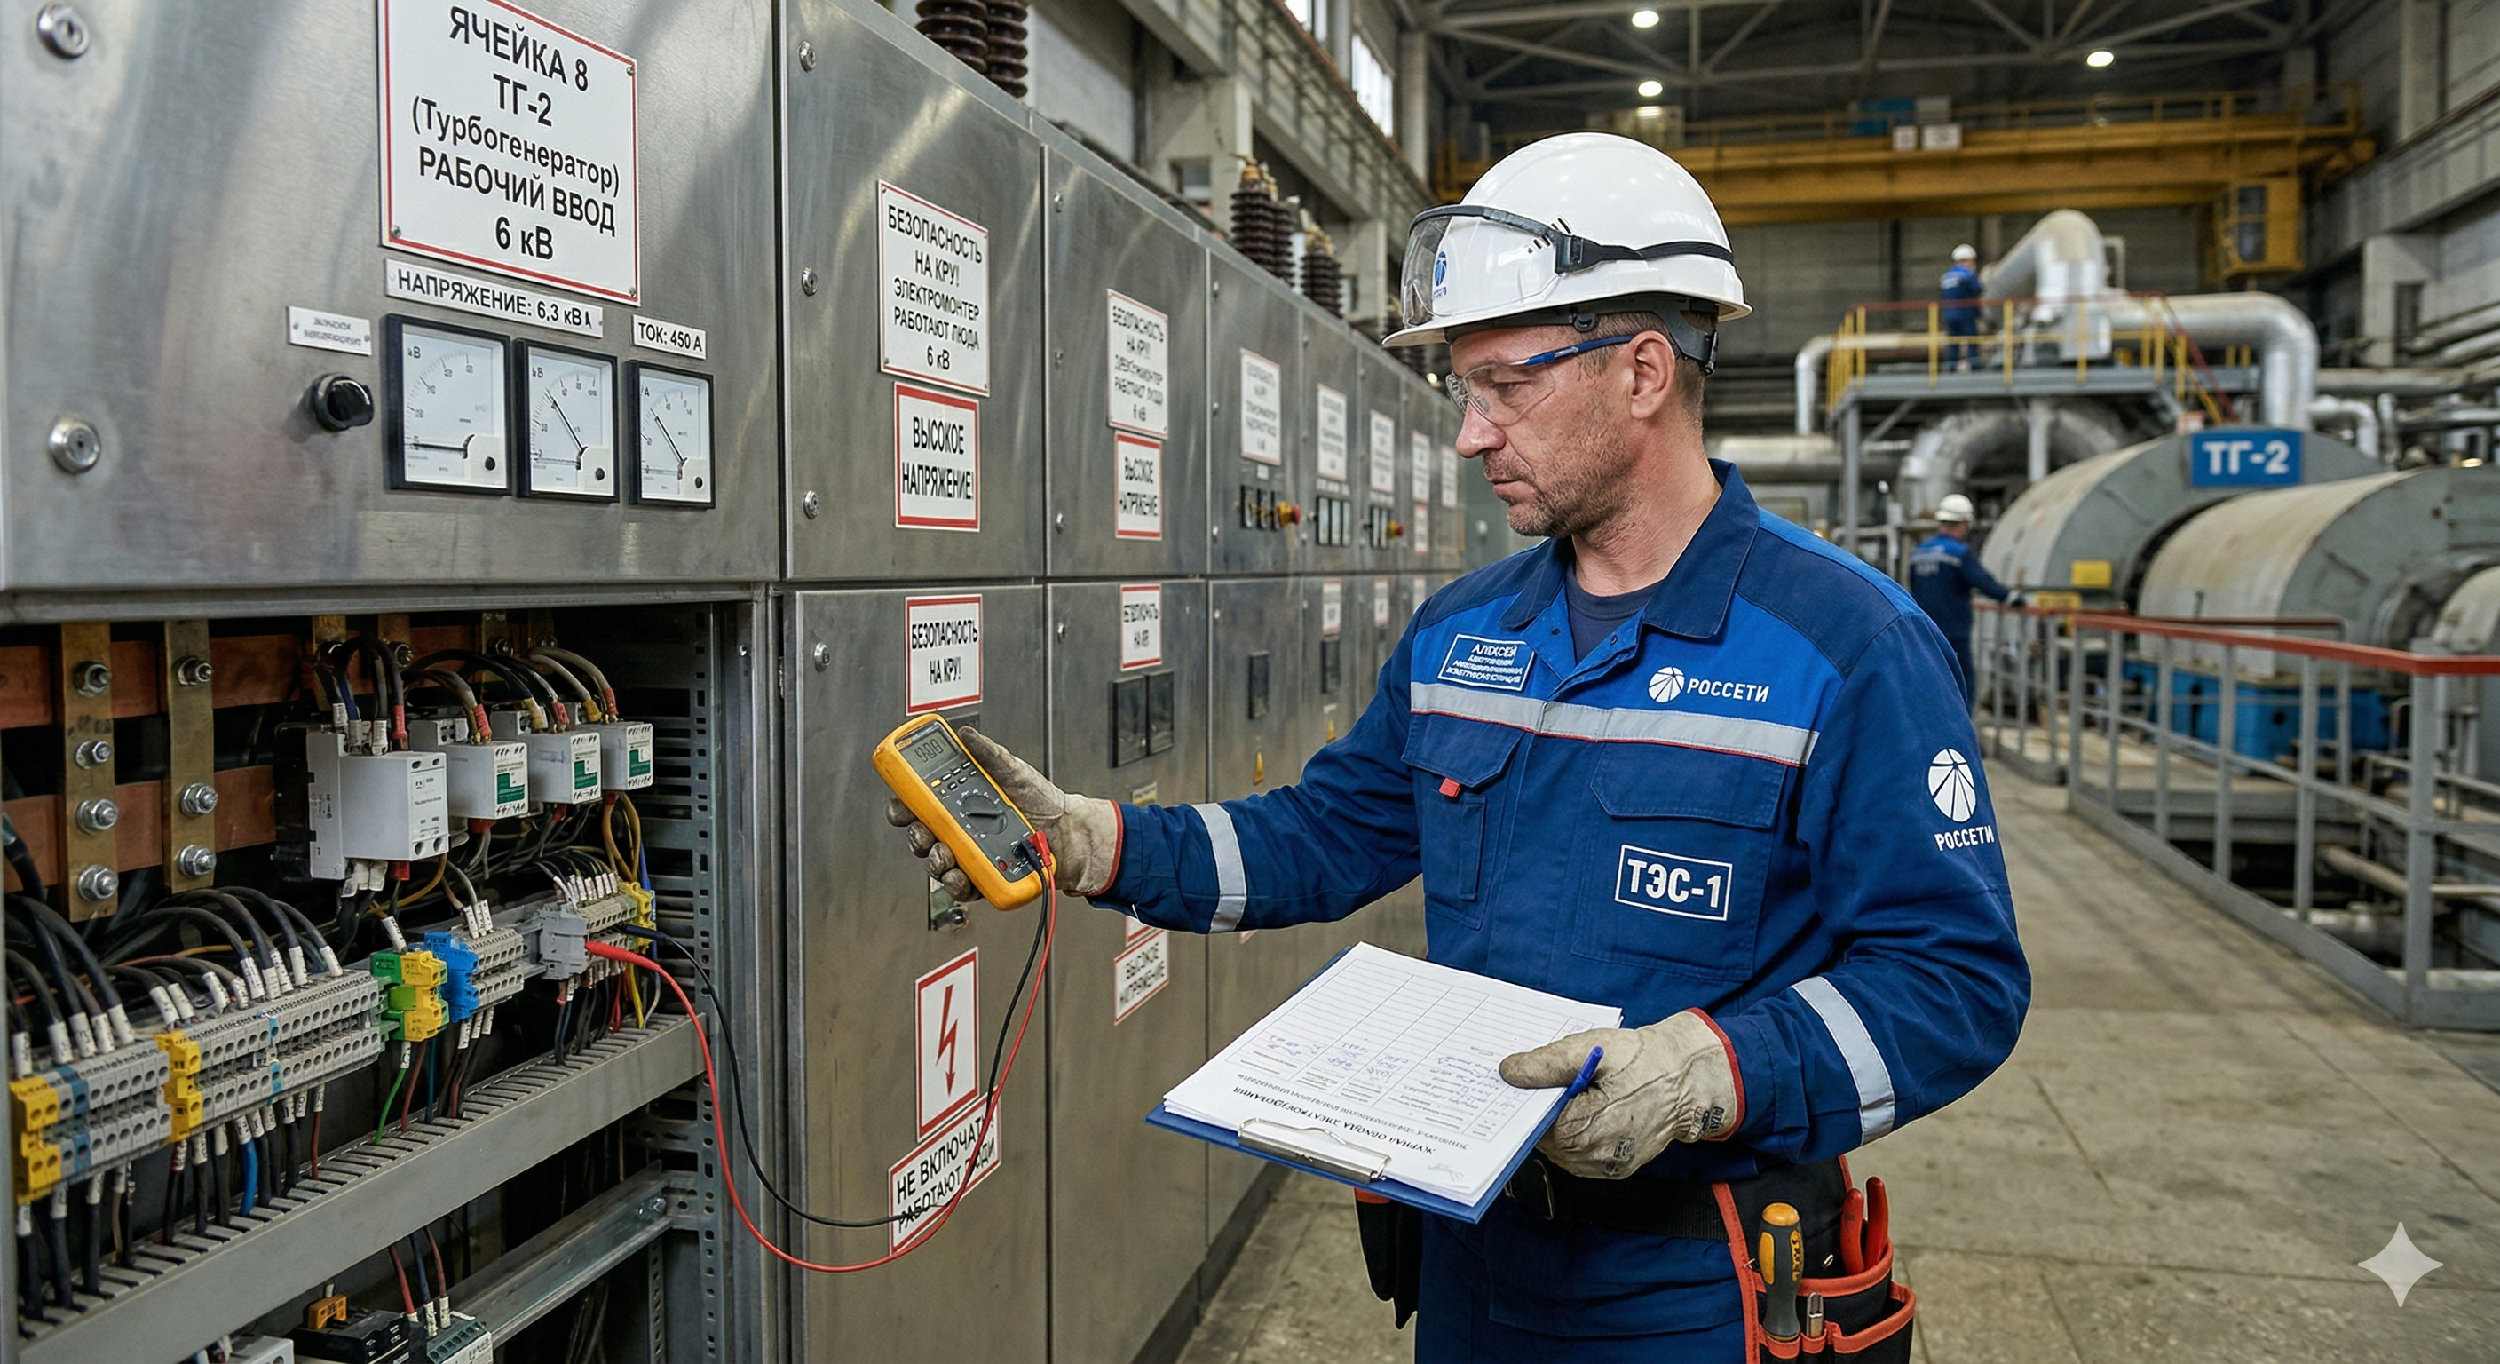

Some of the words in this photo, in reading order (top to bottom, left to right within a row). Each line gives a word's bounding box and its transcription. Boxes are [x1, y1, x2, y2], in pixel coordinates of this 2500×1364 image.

[449, 6, 567, 84] ЯЧЕЙКА
[574, 58, 589, 91] 8
[493, 73, 552, 127] ТГ-2
[412, 95, 620, 197] (Турбогенератор)
[419, 146, 545, 211] РАБОЧИЙ
[552, 187, 616, 237] ВВОД
[495, 216, 511, 250] 6
[520, 225, 553, 260] кВ
[888, 204, 983, 264] БЕЗОПАСНОСТЬ
[914, 250, 932, 278] НА
[935, 257, 960, 288] КРУ!
[398, 269, 532, 317] НАПРЯЖЕНИЕ:
[564, 307, 582, 326] кВ
[638, 322, 668, 345] ТОК:
[669, 331, 691, 349] 450
[692, 336, 703, 352] А
[894, 305, 950, 340] РАБОТАЮТ
[927, 344, 934, 367] 6
[913, 416, 965, 455] ВЫСОКОЕ
[2202, 439, 2291, 476] ТГ-2
[901, 462, 974, 501] НАПРЯЖЕНИЕ!
[912, 619, 978, 649] БЕЗОПАСНОСТЬ
[929, 658, 943, 685] НА
[1686, 677, 1770, 703] РОССЕТИ
[1933, 824, 1995, 852] РОССЕТИ
[1626, 858, 1722, 909] ТЭС-1
[897, 1169, 916, 1205] НЕ
[898, 1165, 962, 1234] РАБОТАЮТ
